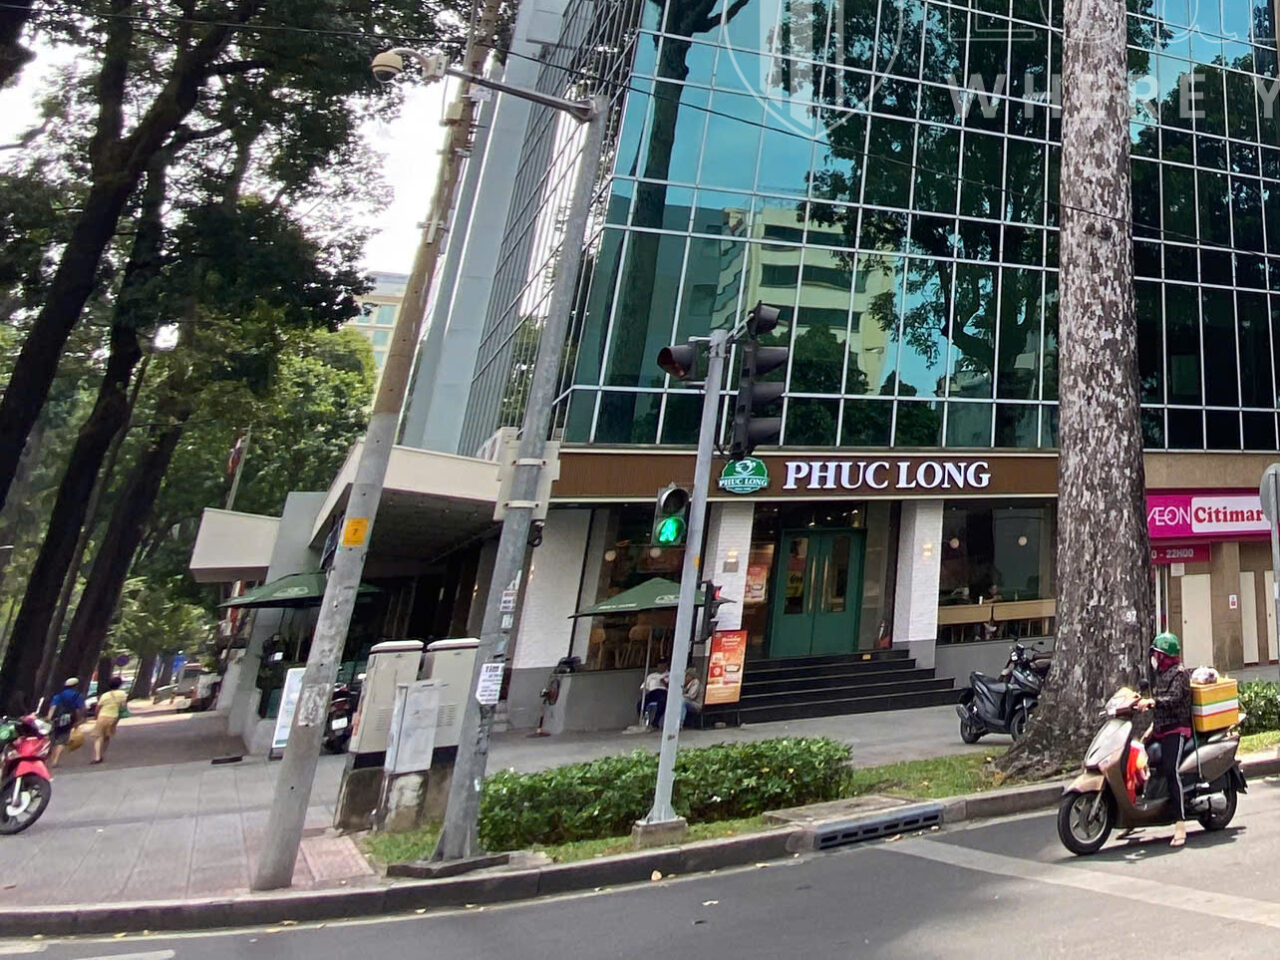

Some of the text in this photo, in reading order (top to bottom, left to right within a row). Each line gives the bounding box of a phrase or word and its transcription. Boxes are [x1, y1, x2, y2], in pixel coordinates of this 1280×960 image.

[744, 478, 768, 487] LONG
[782, 460, 991, 490] PHUC LONG
[1147, 506, 1264, 526] AEON Citimar
